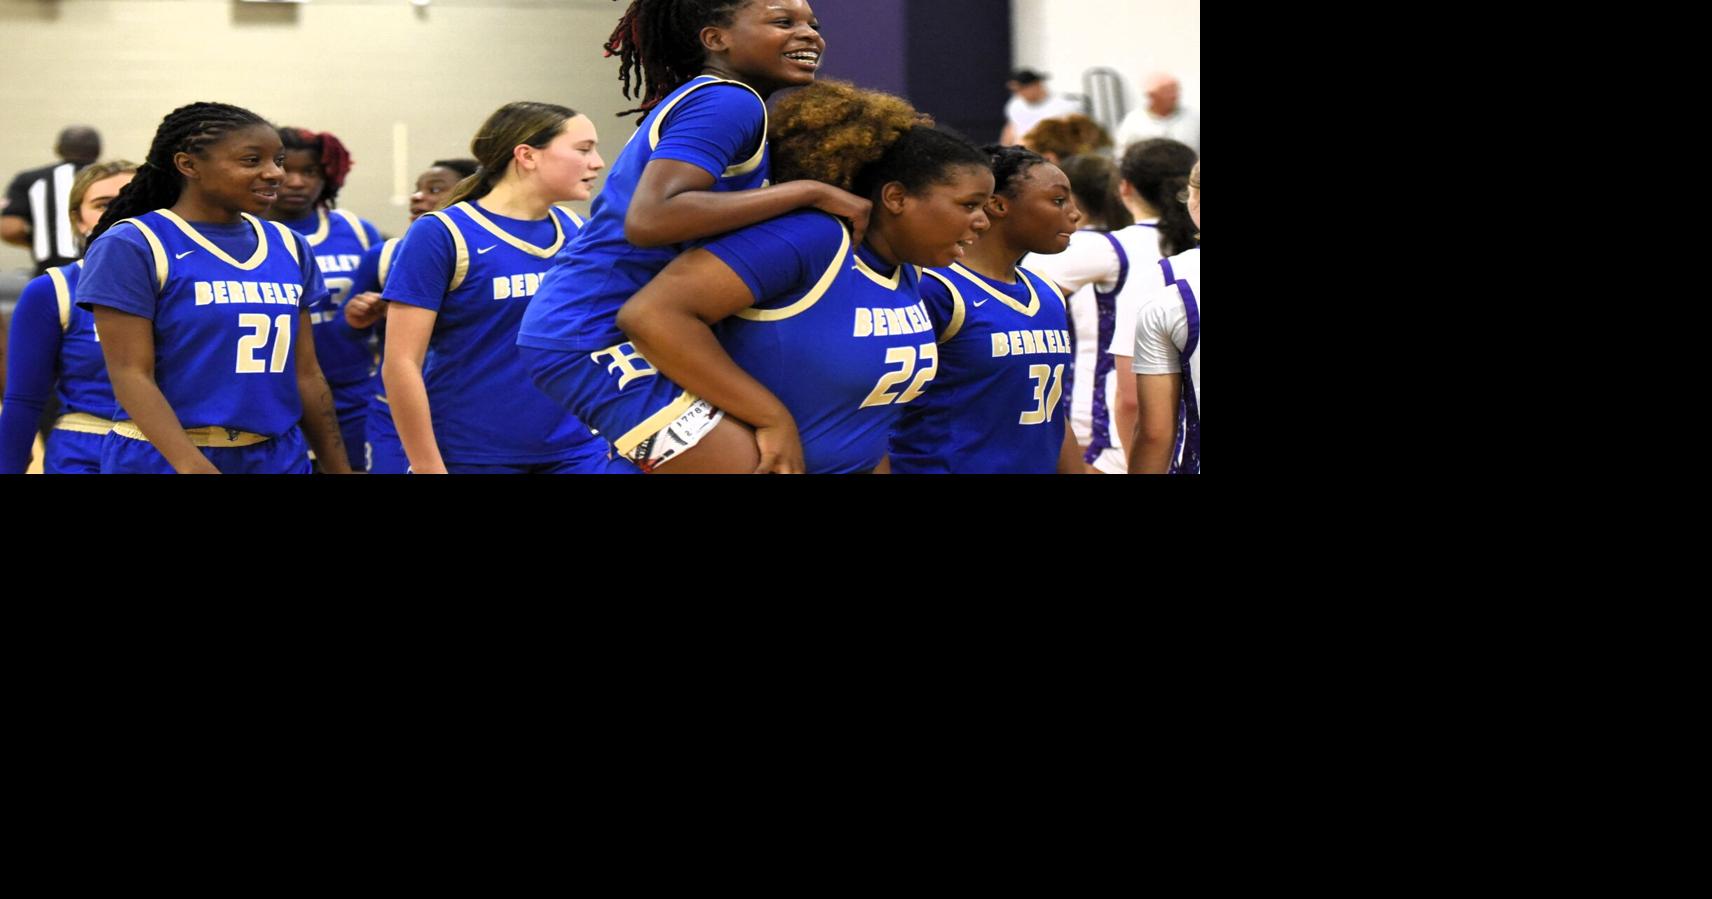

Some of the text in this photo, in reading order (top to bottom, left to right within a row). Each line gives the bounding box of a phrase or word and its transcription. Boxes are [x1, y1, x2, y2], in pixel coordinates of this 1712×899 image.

[493, 272, 546, 300] BER
[235, 313, 291, 373] 21
[858, 342, 938, 409] 22
[1019, 364, 1065, 425] 31
